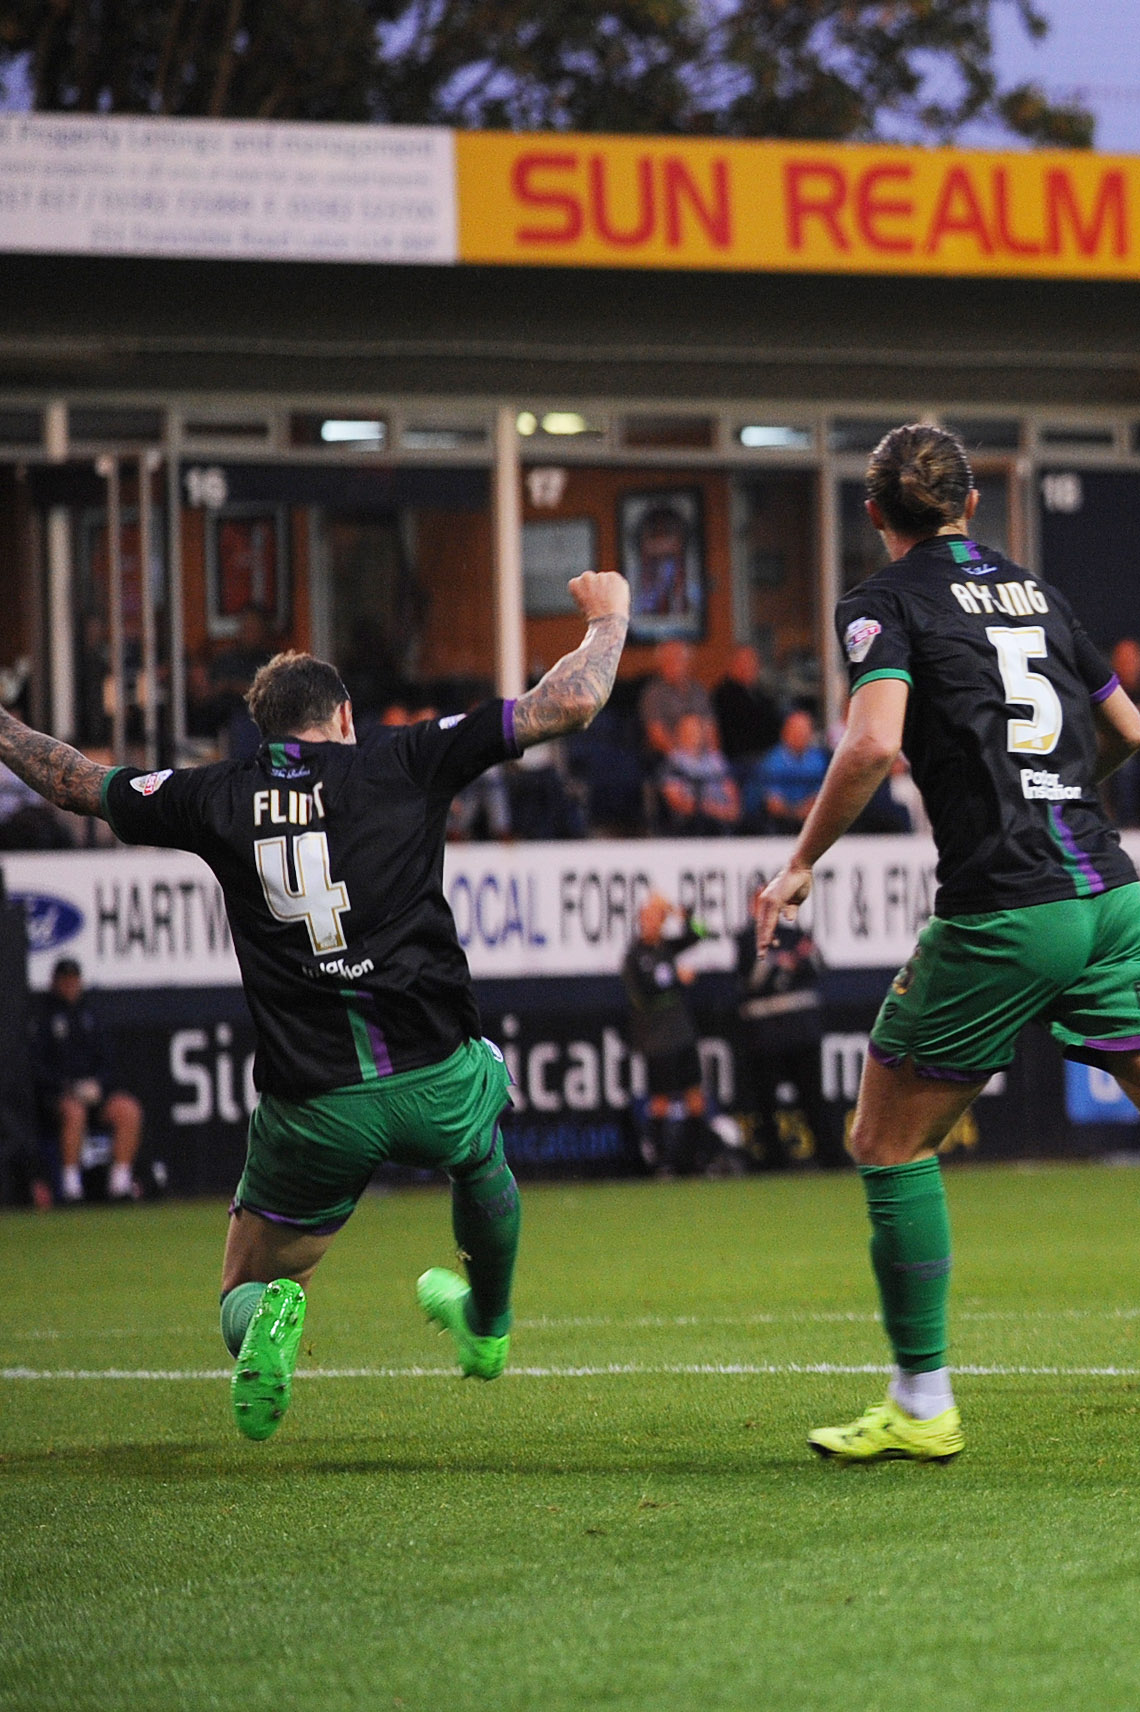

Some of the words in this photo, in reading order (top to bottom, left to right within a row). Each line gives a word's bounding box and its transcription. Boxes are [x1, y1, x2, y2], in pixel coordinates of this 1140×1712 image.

[511, 150, 733, 250] SUN
[782, 158, 1130, 261] REALM
[985, 625, 1063, 755] 5
[95, 879, 232, 953] HARTW
[451, 873, 547, 947] OCAL
[254, 832, 350, 956] 4
